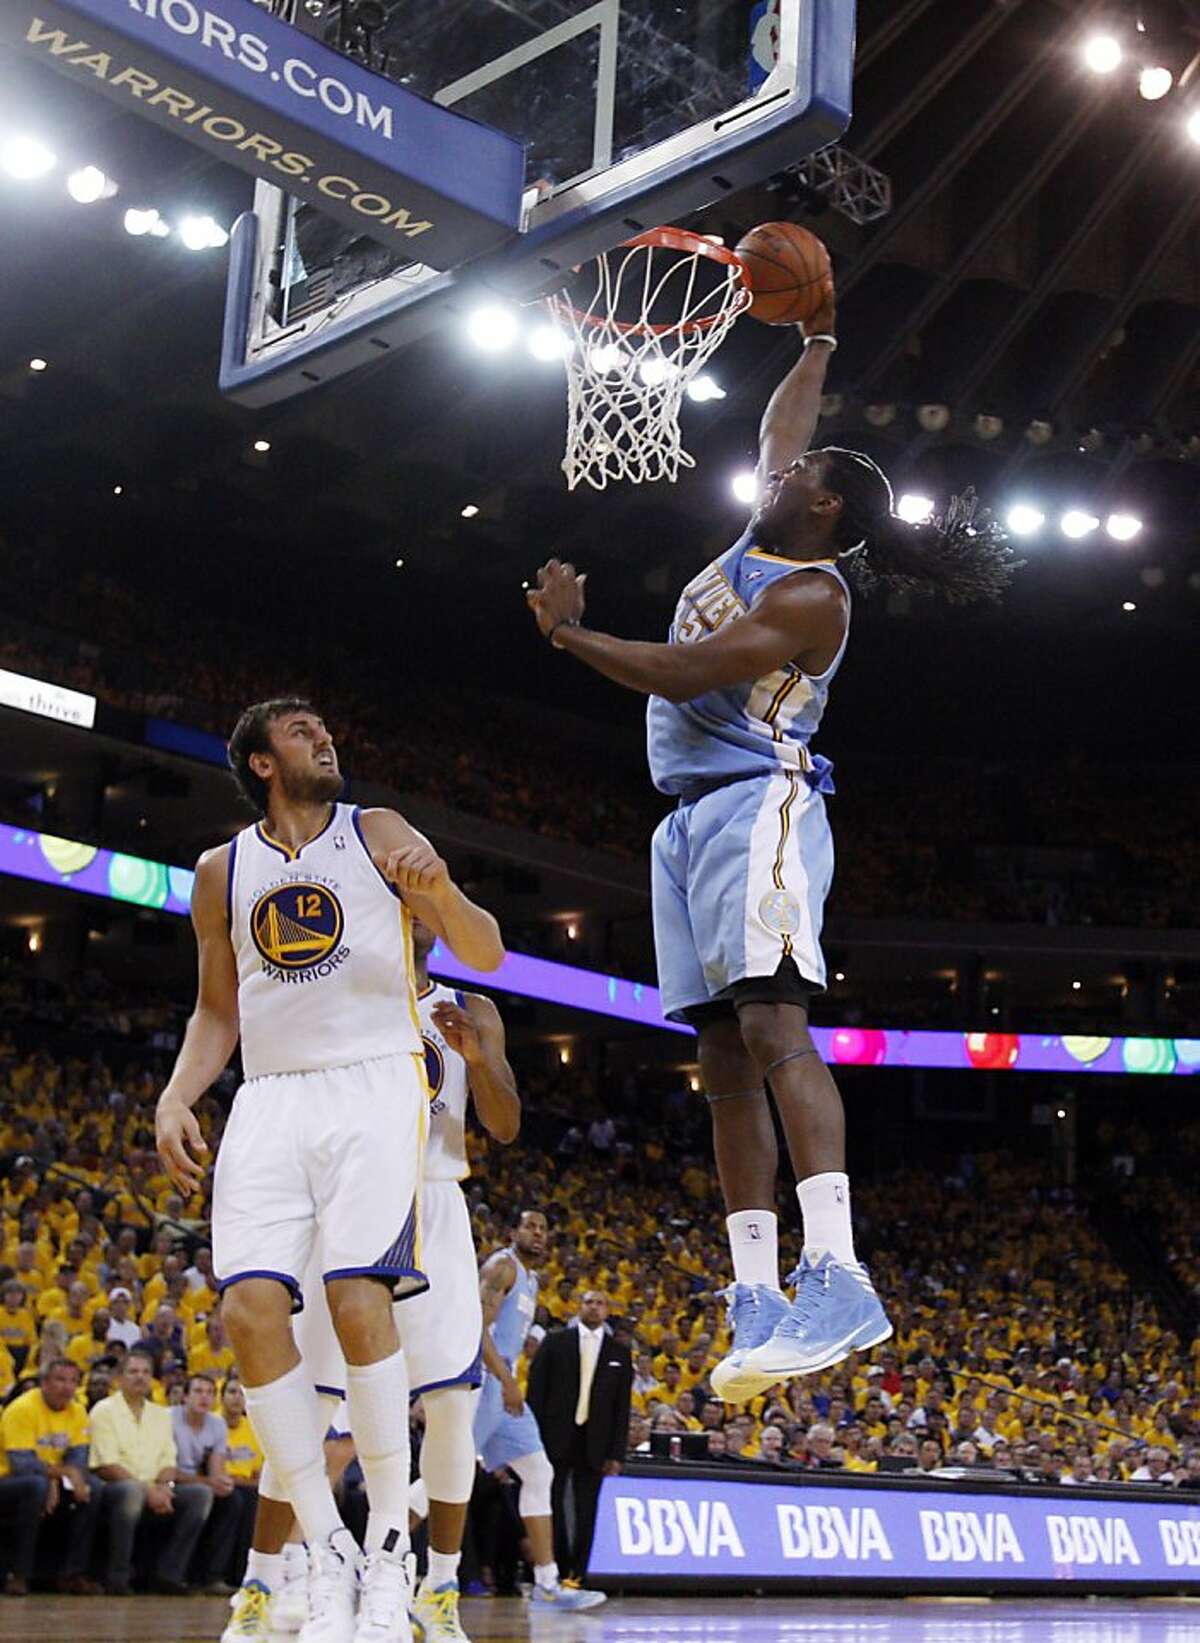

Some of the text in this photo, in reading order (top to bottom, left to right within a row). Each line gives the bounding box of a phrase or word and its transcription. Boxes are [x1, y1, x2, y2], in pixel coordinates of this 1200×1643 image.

[127, 0, 393, 139] IORS.COM
[25, 17, 434, 238] WARRIORS.COM
[296, 893, 322, 918] 12
[261, 944, 351, 984] WARRIORS
[615, 1497, 745, 1558] BBVA
[776, 1504, 893, 1561] BBVA
[919, 1509, 1024, 1563] BBVA
[1046, 1515, 1141, 1566] BBVA
